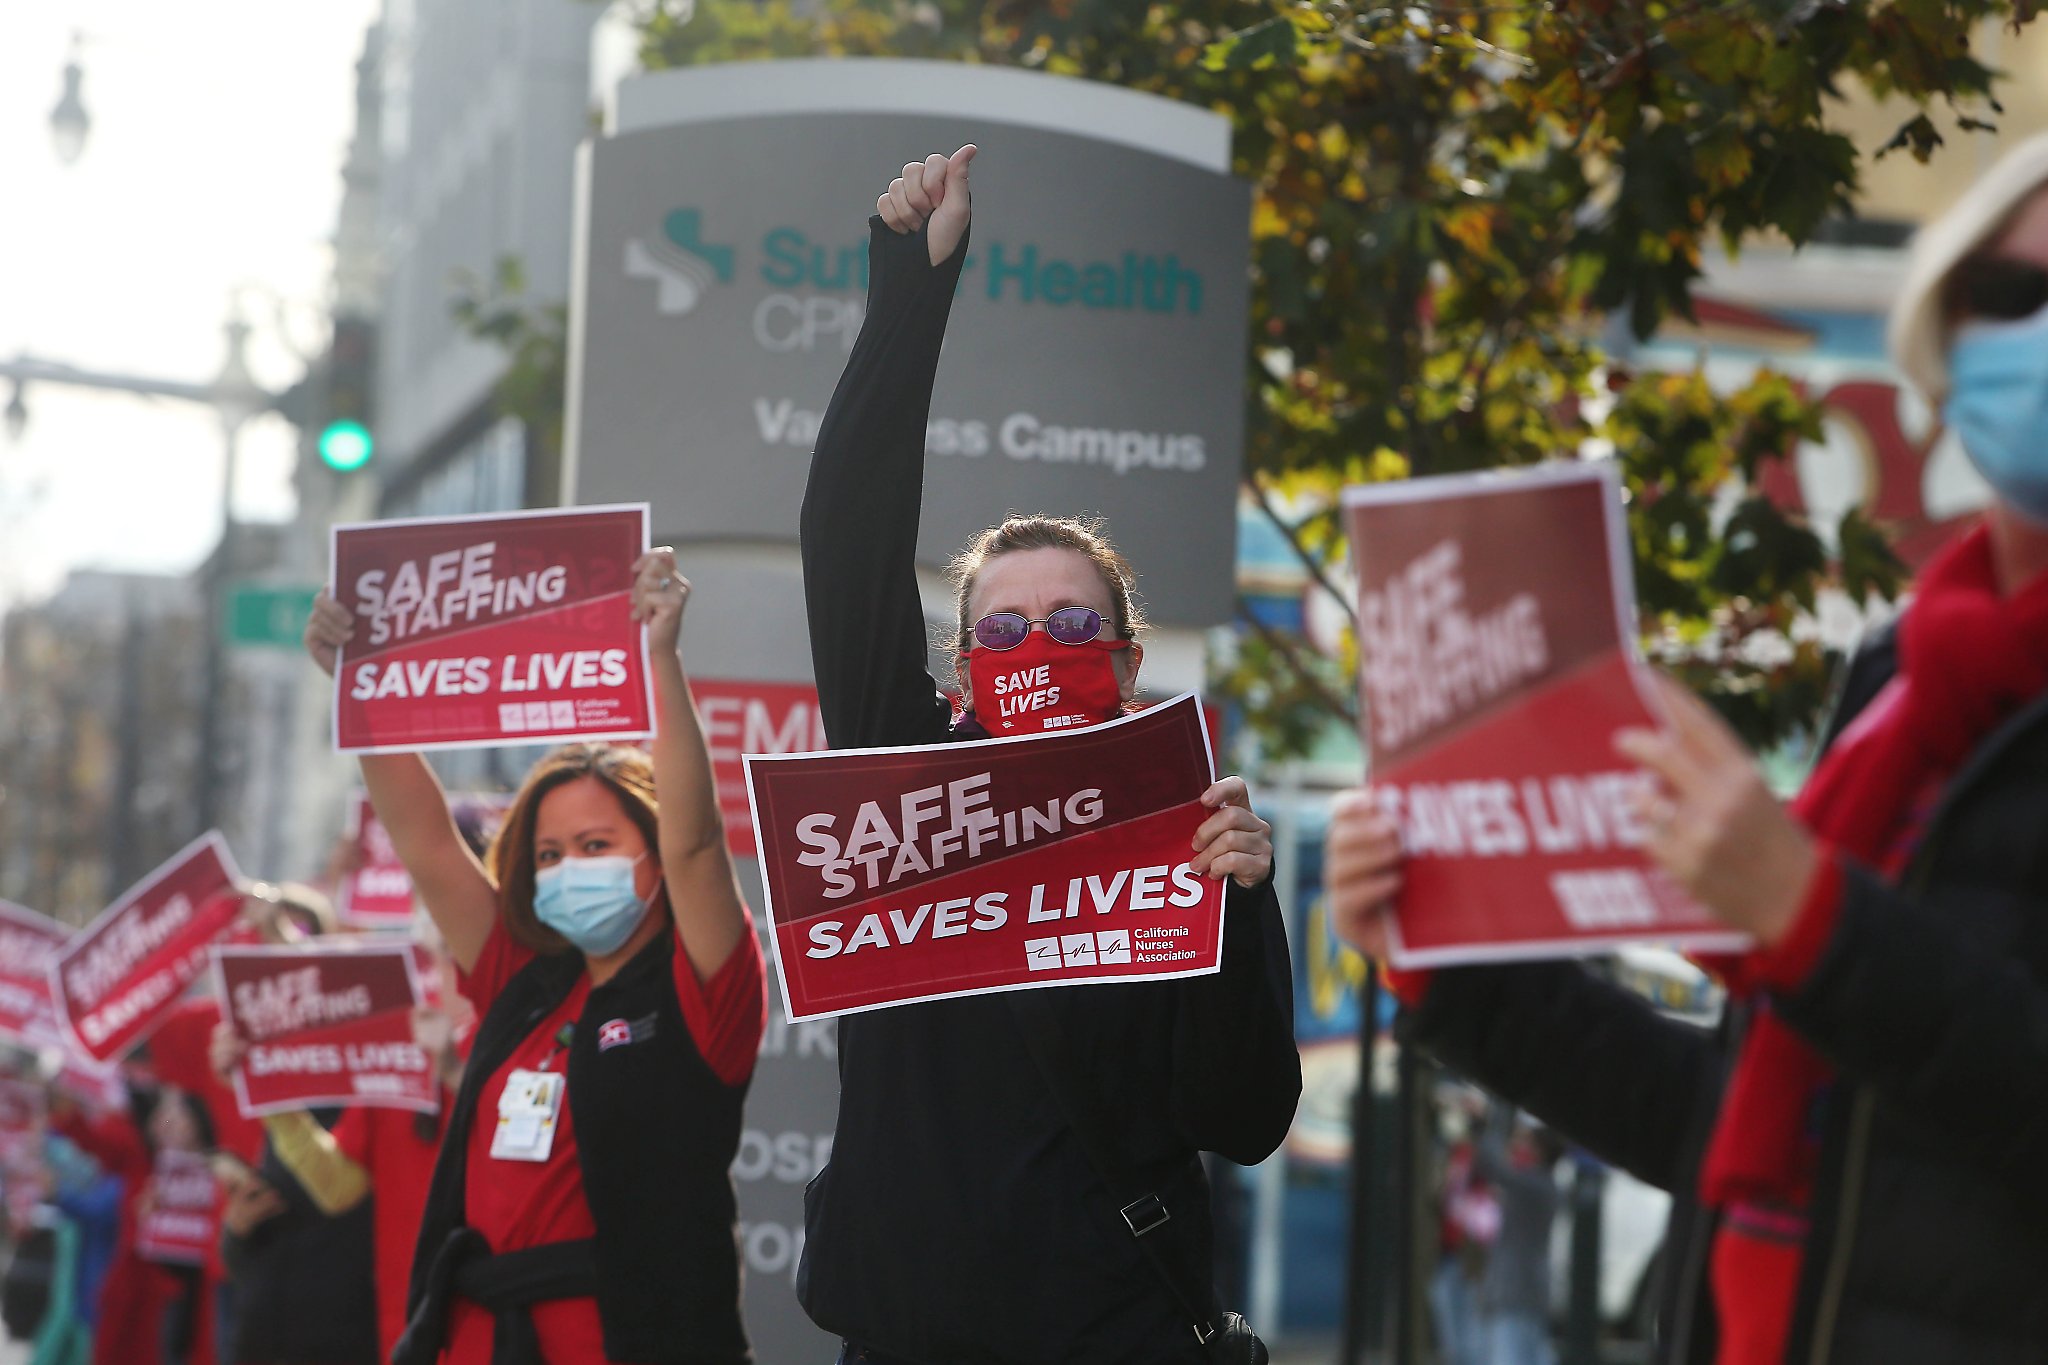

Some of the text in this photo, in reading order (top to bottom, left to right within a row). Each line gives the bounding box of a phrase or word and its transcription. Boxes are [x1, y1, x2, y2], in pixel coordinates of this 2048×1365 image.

[986, 243, 1203, 314] Health
[753, 294, 867, 352] CP
[1001, 413, 1205, 475] Campus
[355, 542, 497, 617] SAFE
[369, 565, 567, 646] STAFFING
[351, 649, 628, 701] SAVES LIVES
[994, 664, 1050, 695] SAVE
[999, 686, 1060, 718] LIVES
[796, 772, 994, 867] SAFE
[821, 788, 1104, 899] STAFFING
[805, 862, 1205, 959] SAVES LIVES
[1134, 926, 1189, 939] California
[1135, 940, 1174, 951] Nurses
[1136, 950, 1196, 963] Association
